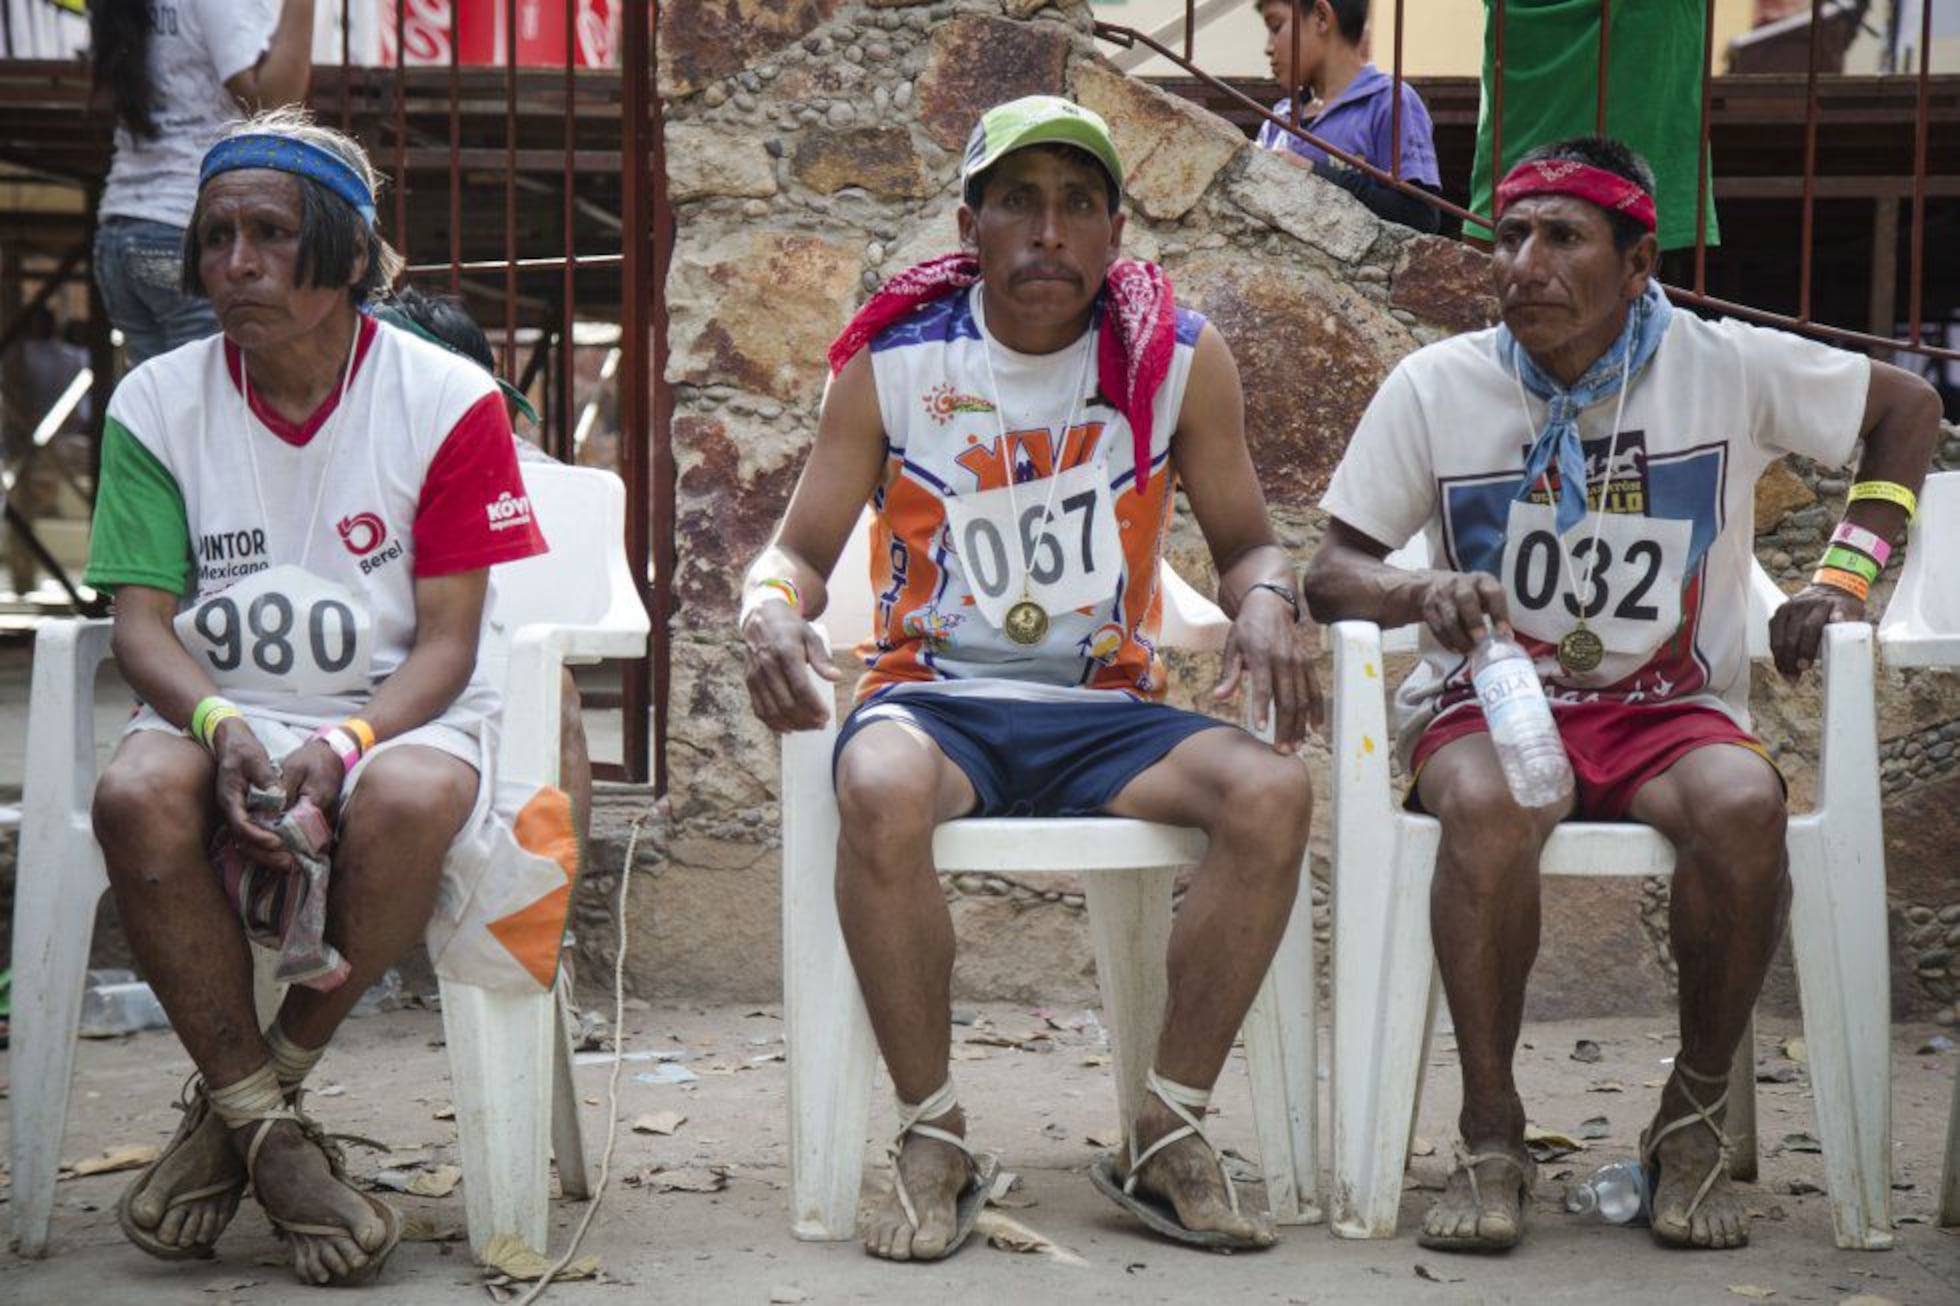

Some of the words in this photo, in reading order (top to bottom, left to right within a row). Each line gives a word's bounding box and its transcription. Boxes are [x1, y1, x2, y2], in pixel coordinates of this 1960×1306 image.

[359, 539, 404, 576] Berel
[963, 489, 1098, 598] 067
[1513, 530, 1663, 621] 032
[194, 592, 357, 676] 980
